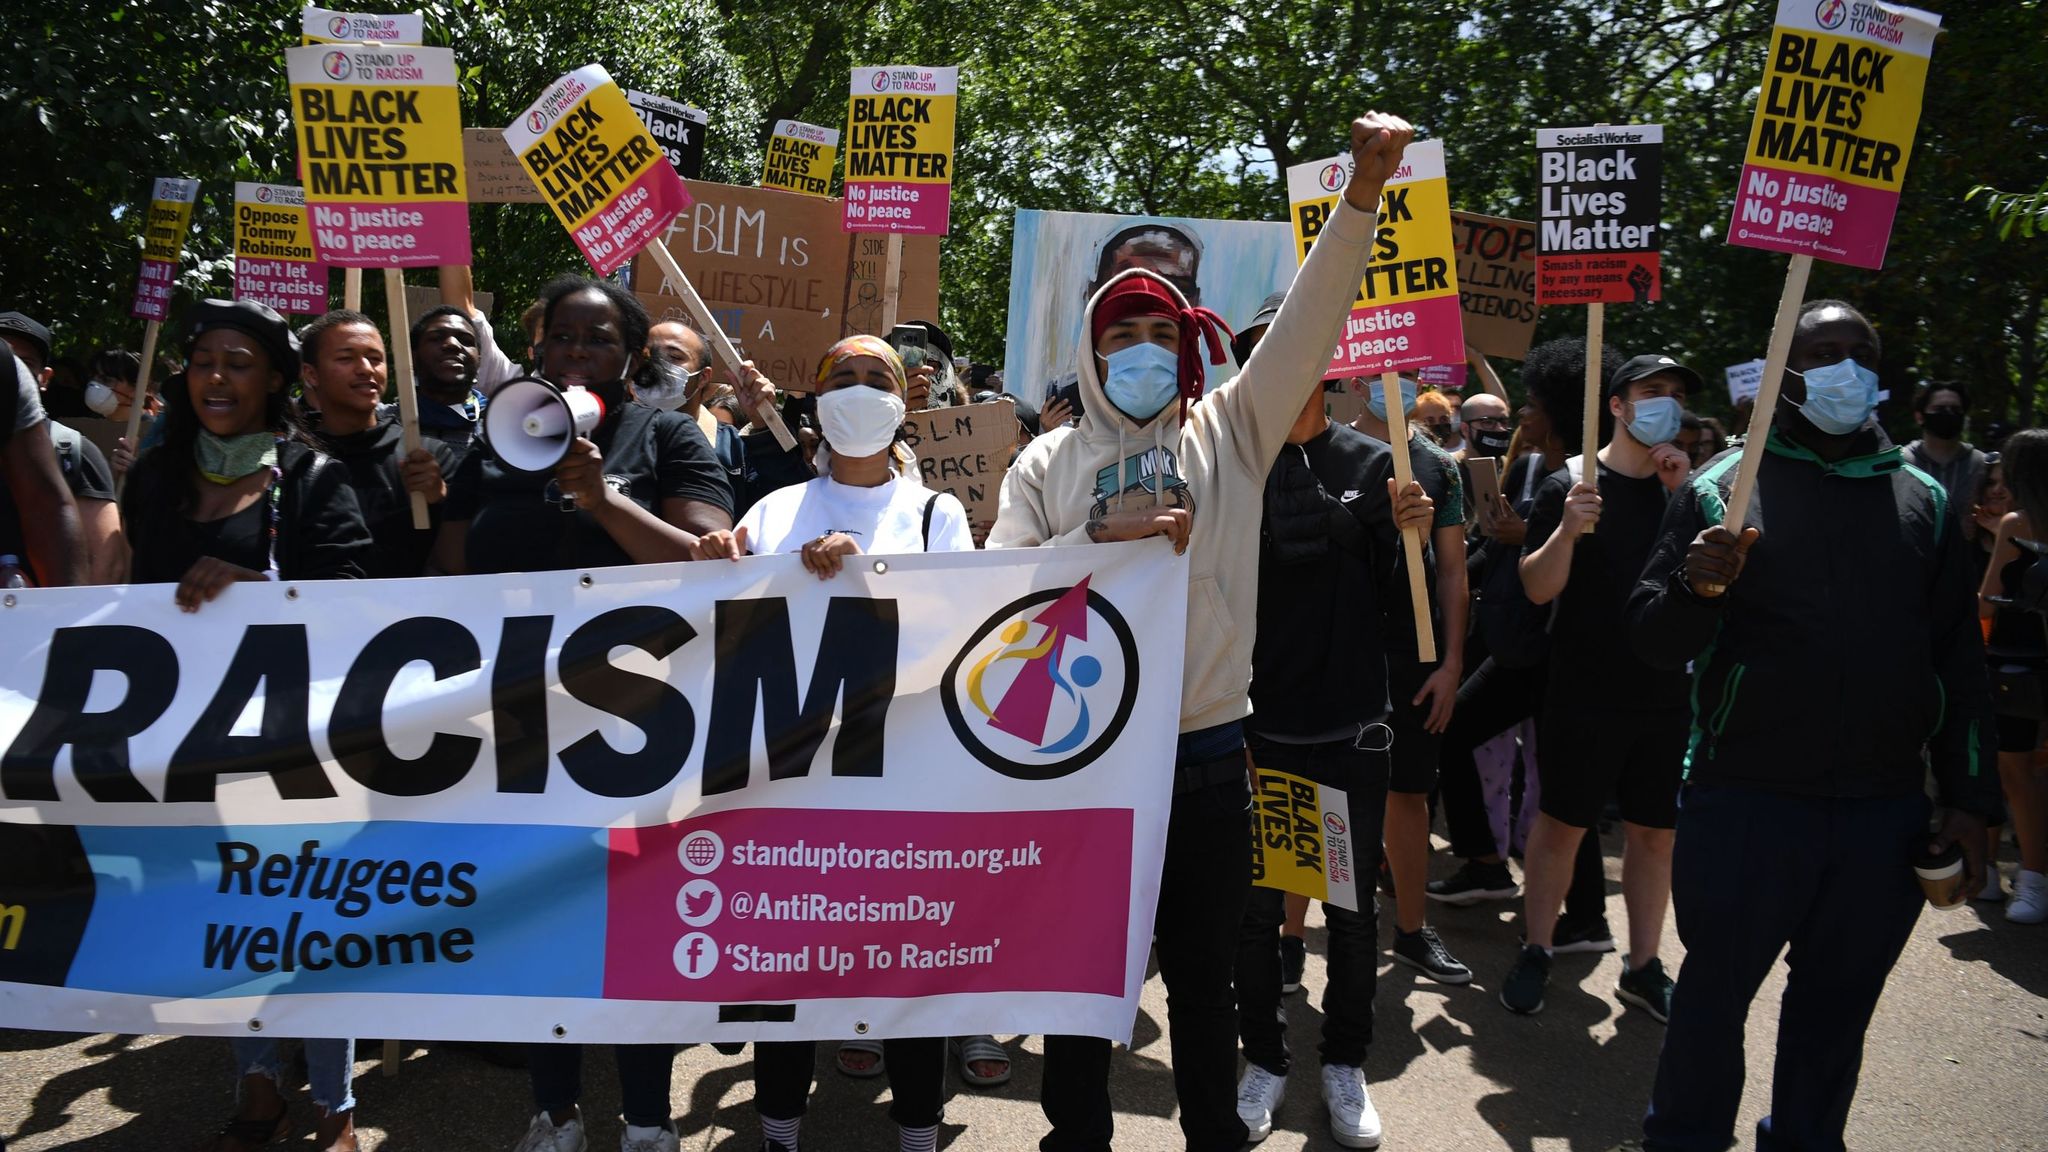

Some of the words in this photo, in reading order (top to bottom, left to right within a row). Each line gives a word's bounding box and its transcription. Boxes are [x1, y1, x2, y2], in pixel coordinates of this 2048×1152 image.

[353, 19, 382, 29] STAND
[383, 20, 396, 29] UP
[1851, 2, 1887, 23] STAND
[1888, 12, 1904, 26] UP
[353, 29, 365, 39] TO
[367, 30, 399, 39] RACISM
[1850, 17, 1865, 34] TO
[1867, 23, 1903, 44] RACISM
[355, 54, 393, 66] STAND
[397, 54, 415, 66] UP
[356, 67, 372, 79] TO
[375, 68, 423, 80] RACISM
[1774, 33, 1894, 93] BLACK
[892, 72, 918, 81] STAND
[920, 72, 932, 81] UP
[892, 81, 902, 90] TO
[903, 83, 936, 92] RACISM
[299, 88, 422, 124] BLACK
[541, 87, 565, 112] STAND
[563, 78, 576, 91] UP
[548, 107, 559, 119] TO
[557, 83, 587, 111] RACISM
[1765, 76, 1866, 130] LIVES
[641, 98, 672, 112] Socialist
[671, 106, 696, 120] Worker
[853, 97, 932, 123] BLACK
[304, 126, 407, 160] LIVES
[525, 99, 604, 177] BLACK
[772, 137, 821, 160] BLACK
[852, 125, 916, 150] LIVES
[1557, 134, 1603, 146] Socialist
[1604, 132, 1643, 145] Worker
[1755, 119, 1901, 182] MATTER
[540, 134, 610, 201] LIVES
[769, 153, 810, 174] LIVES
[850, 152, 947, 178] MATTER
[1541, 149, 1637, 184] Black
[309, 162, 458, 196] MATTER
[557, 134, 655, 225] MATTER
[766, 168, 826, 194] MATTER
[1747, 171, 1779, 198] No
[1781, 177, 1848, 212] justice
[274, 188, 296, 198] STAND
[274, 196, 284, 204] TO
[285, 197, 305, 206] RACIS
[848, 185, 866, 200] No
[868, 185, 920, 204] justice
[1541, 186, 1627, 218] Lives
[239, 206, 298, 227] Oppose
[313, 206, 345, 227] No
[349, 207, 424, 232] justice
[577, 223, 602, 246] No
[599, 186, 649, 233] justice
[847, 203, 865, 218] No
[868, 205, 911, 221] peace
[1741, 198, 1773, 225] No
[1777, 210, 1833, 236] peace
[239, 223, 297, 244] Tommy
[316, 229, 348, 250] No
[352, 234, 416, 254] peace
[588, 242, 613, 262] No
[613, 207, 655, 249] peace
[863, 239, 884, 255] SIDE
[1541, 219, 1655, 251] Matter
[239, 239, 312, 258] Robinson
[780, 237, 809, 266] IS
[238, 259, 282, 276] Don't
[286, 262, 308, 279] let
[1542, 259, 1584, 271] Smash
[1586, 258, 1627, 269] racism
[238, 276, 265, 292] the
[270, 279, 325, 296] racists
[1355, 257, 1449, 302] TTER
[1542, 274, 1555, 286] by
[1559, 275, 1580, 286] any
[1584, 272, 1623, 283] means
[291, 298, 310, 311] us
[1459, 290, 1536, 323] RIENDS
[1542, 287, 1603, 299] necessary
[758, 320, 774, 340] A
[1346, 310, 1416, 340] justice
[1349, 335, 1409, 362] peace
[920, 454, 989, 483] RACE
[0, 597, 898, 803] RACISM
[1259, 775, 1293, 852] LIVES
[1290, 780, 1322, 875] BLACK
[1327, 836, 1337, 848] TO
[1337, 837, 1349, 866] STAND
[731, 840, 1042, 875] standuptoracism.org.uk
[1329, 849, 1341, 884] RACISM
[216, 840, 478, 918] Refugees
[1339, 868, 1350, 882] UP
[730, 892, 956, 926] @AntiRacismDay
[203, 912, 475, 973] welcome
[818, 945, 855, 976] Up
[863, 944, 892, 970] To
